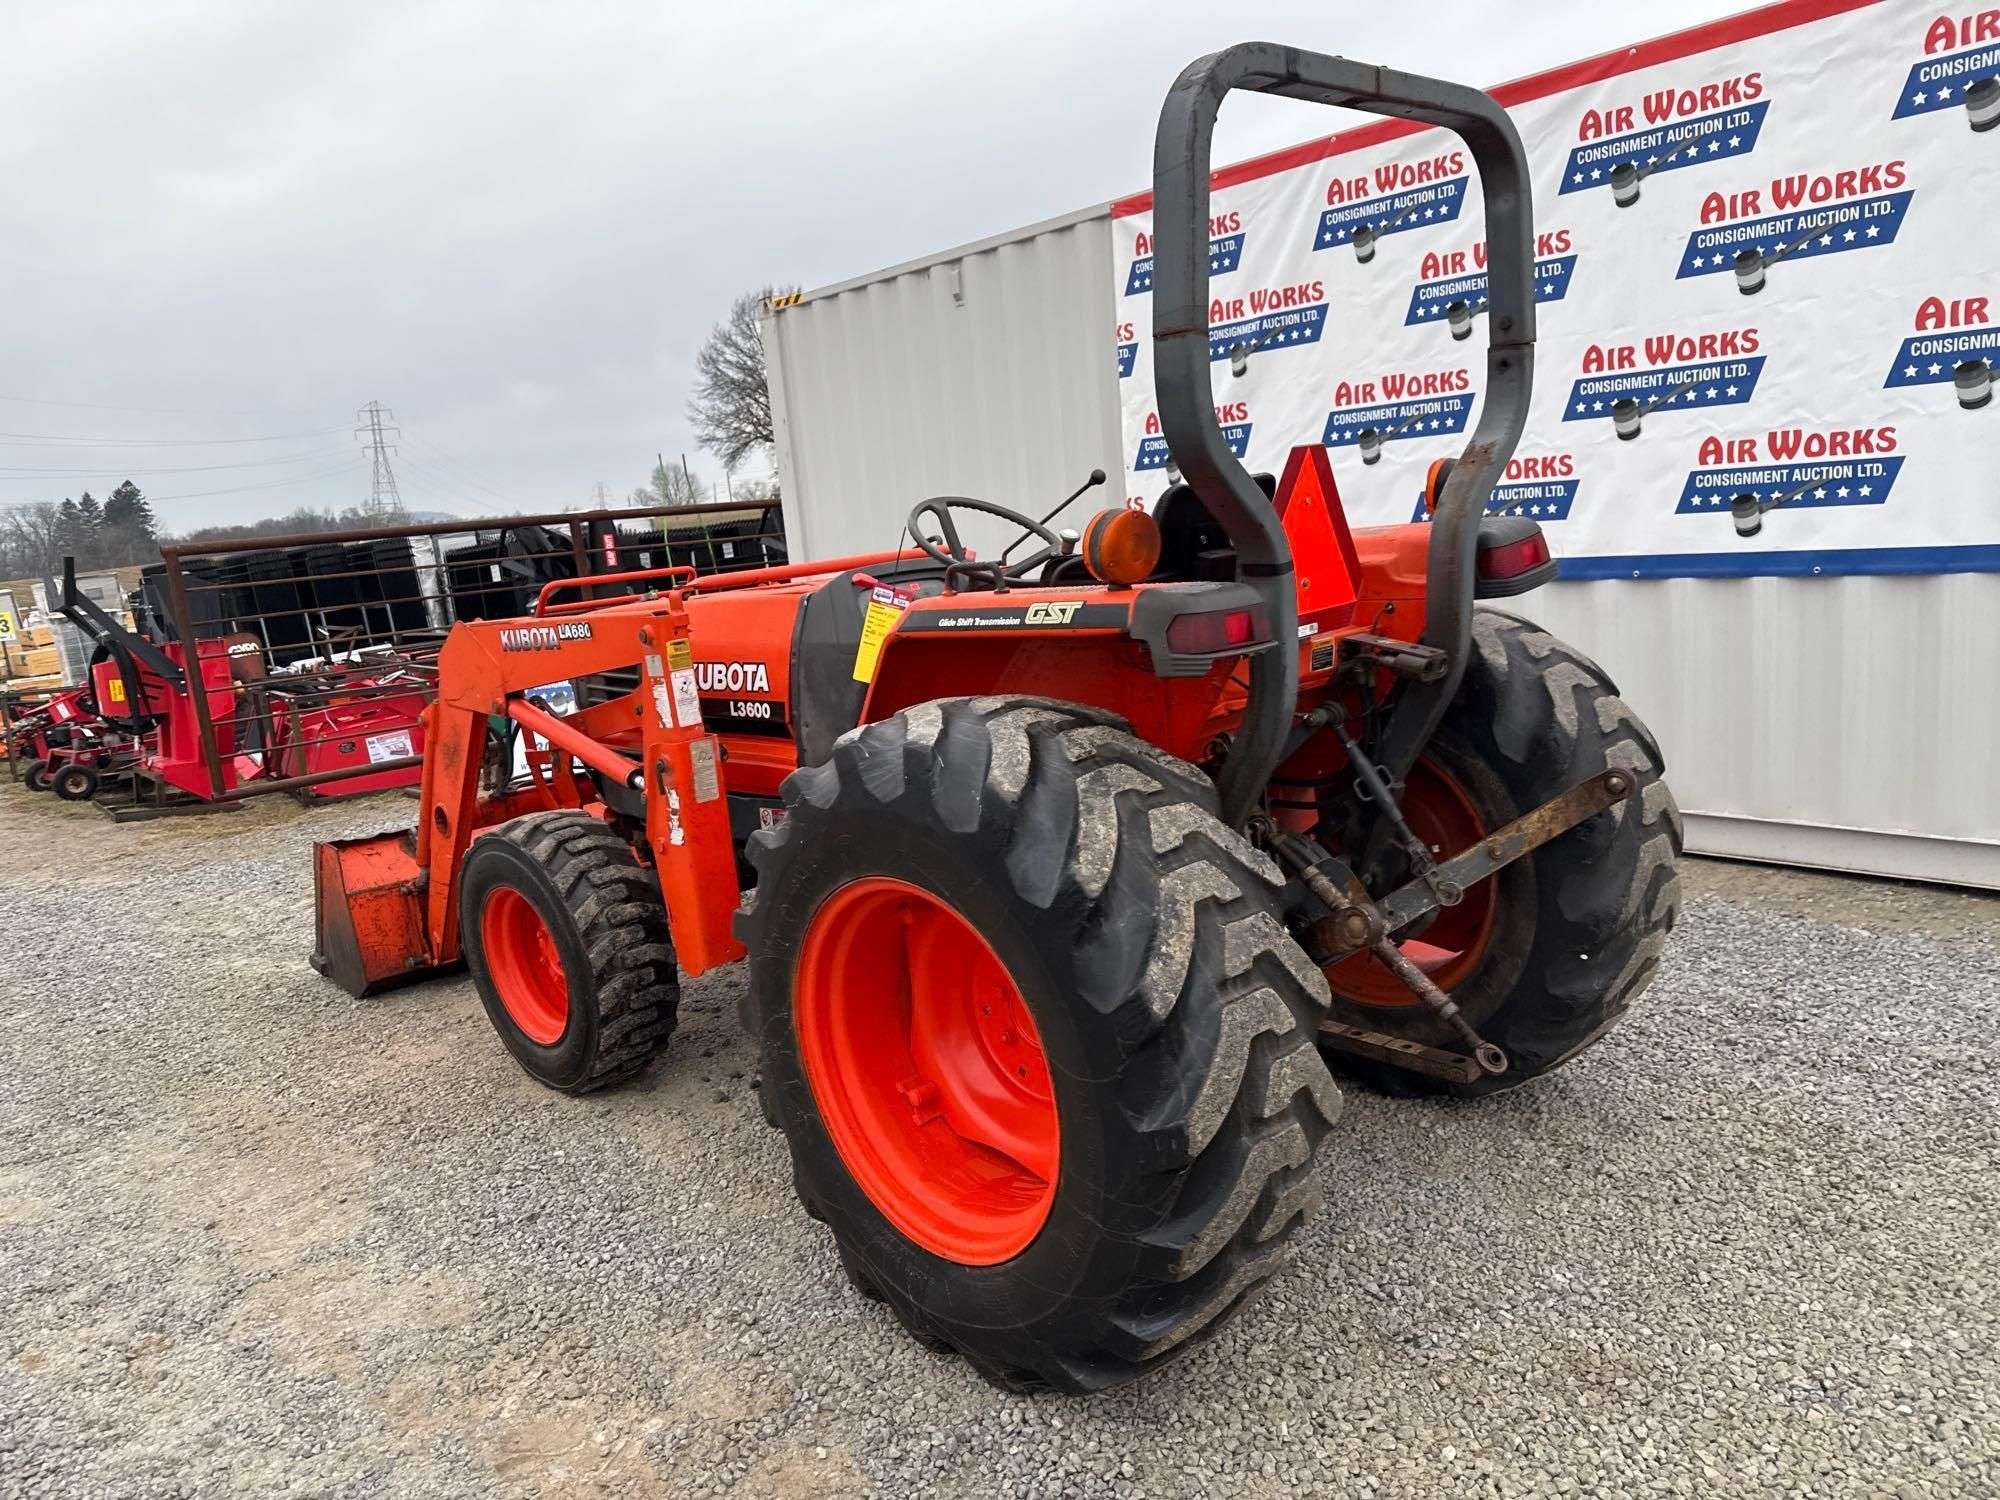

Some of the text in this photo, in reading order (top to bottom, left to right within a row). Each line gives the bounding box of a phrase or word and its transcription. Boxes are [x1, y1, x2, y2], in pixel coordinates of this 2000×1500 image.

[1924, 9, 2000, 55] AIR
[1920, 49, 2000, 82] CONSIGN
[1579, 72, 1763, 142] AIR WORKS
[1577, 111, 1754, 165] CONSIGNMENT AUCTION LTD.
[1327, 152, 1464, 206] AIR WORKS
[1700, 160, 1906, 224] AIR WORKS
[1326, 184, 1458, 226] CONSIGNMENT AUCTION LTD.
[1208, 211, 1241, 237] RKS
[1697, 200, 1896, 249] CONSIGNMENT AUCTION LTD.
[1220, 240, 1238, 252] LTD.
[1420, 252, 1466, 280] AIR
[1420, 276, 1488, 300] CONSIGNMENT
[1542, 262, 1565, 278] LTD.
[1210, 280, 1324, 324] AIR WORKS
[1915, 296, 1990, 332] AIR
[1208, 310, 1320, 342] CONSIGNMENT AUCTION LTD.
[1582, 328, 1760, 374] AIR WORKS
[1910, 332, 2000, 356] CONSIGNM
[1335, 368, 1470, 407] AIR WORKS
[1580, 364, 1751, 396] CONSIGNMENT AUCTION LTD.
[1334, 399, 1464, 426] CONSIGNMENT AUCTION LTD.
[1227, 428, 1245, 440] LTD.
[1698, 426, 1897, 466] AIR WORKS
[1506, 454, 1574, 480] ORKS
[1695, 463, 1887, 488] CONSIGNMENT AUCTION LTD.
[1497, 486, 1543, 501] AUCTION
[1545, 484, 1568, 498] LTD.
[938, 601, 1084, 627] Glide Shift Transmission GST
[500, 623, 592, 651] KUBOTA LA680
[730, 700, 770, 719] L3600
